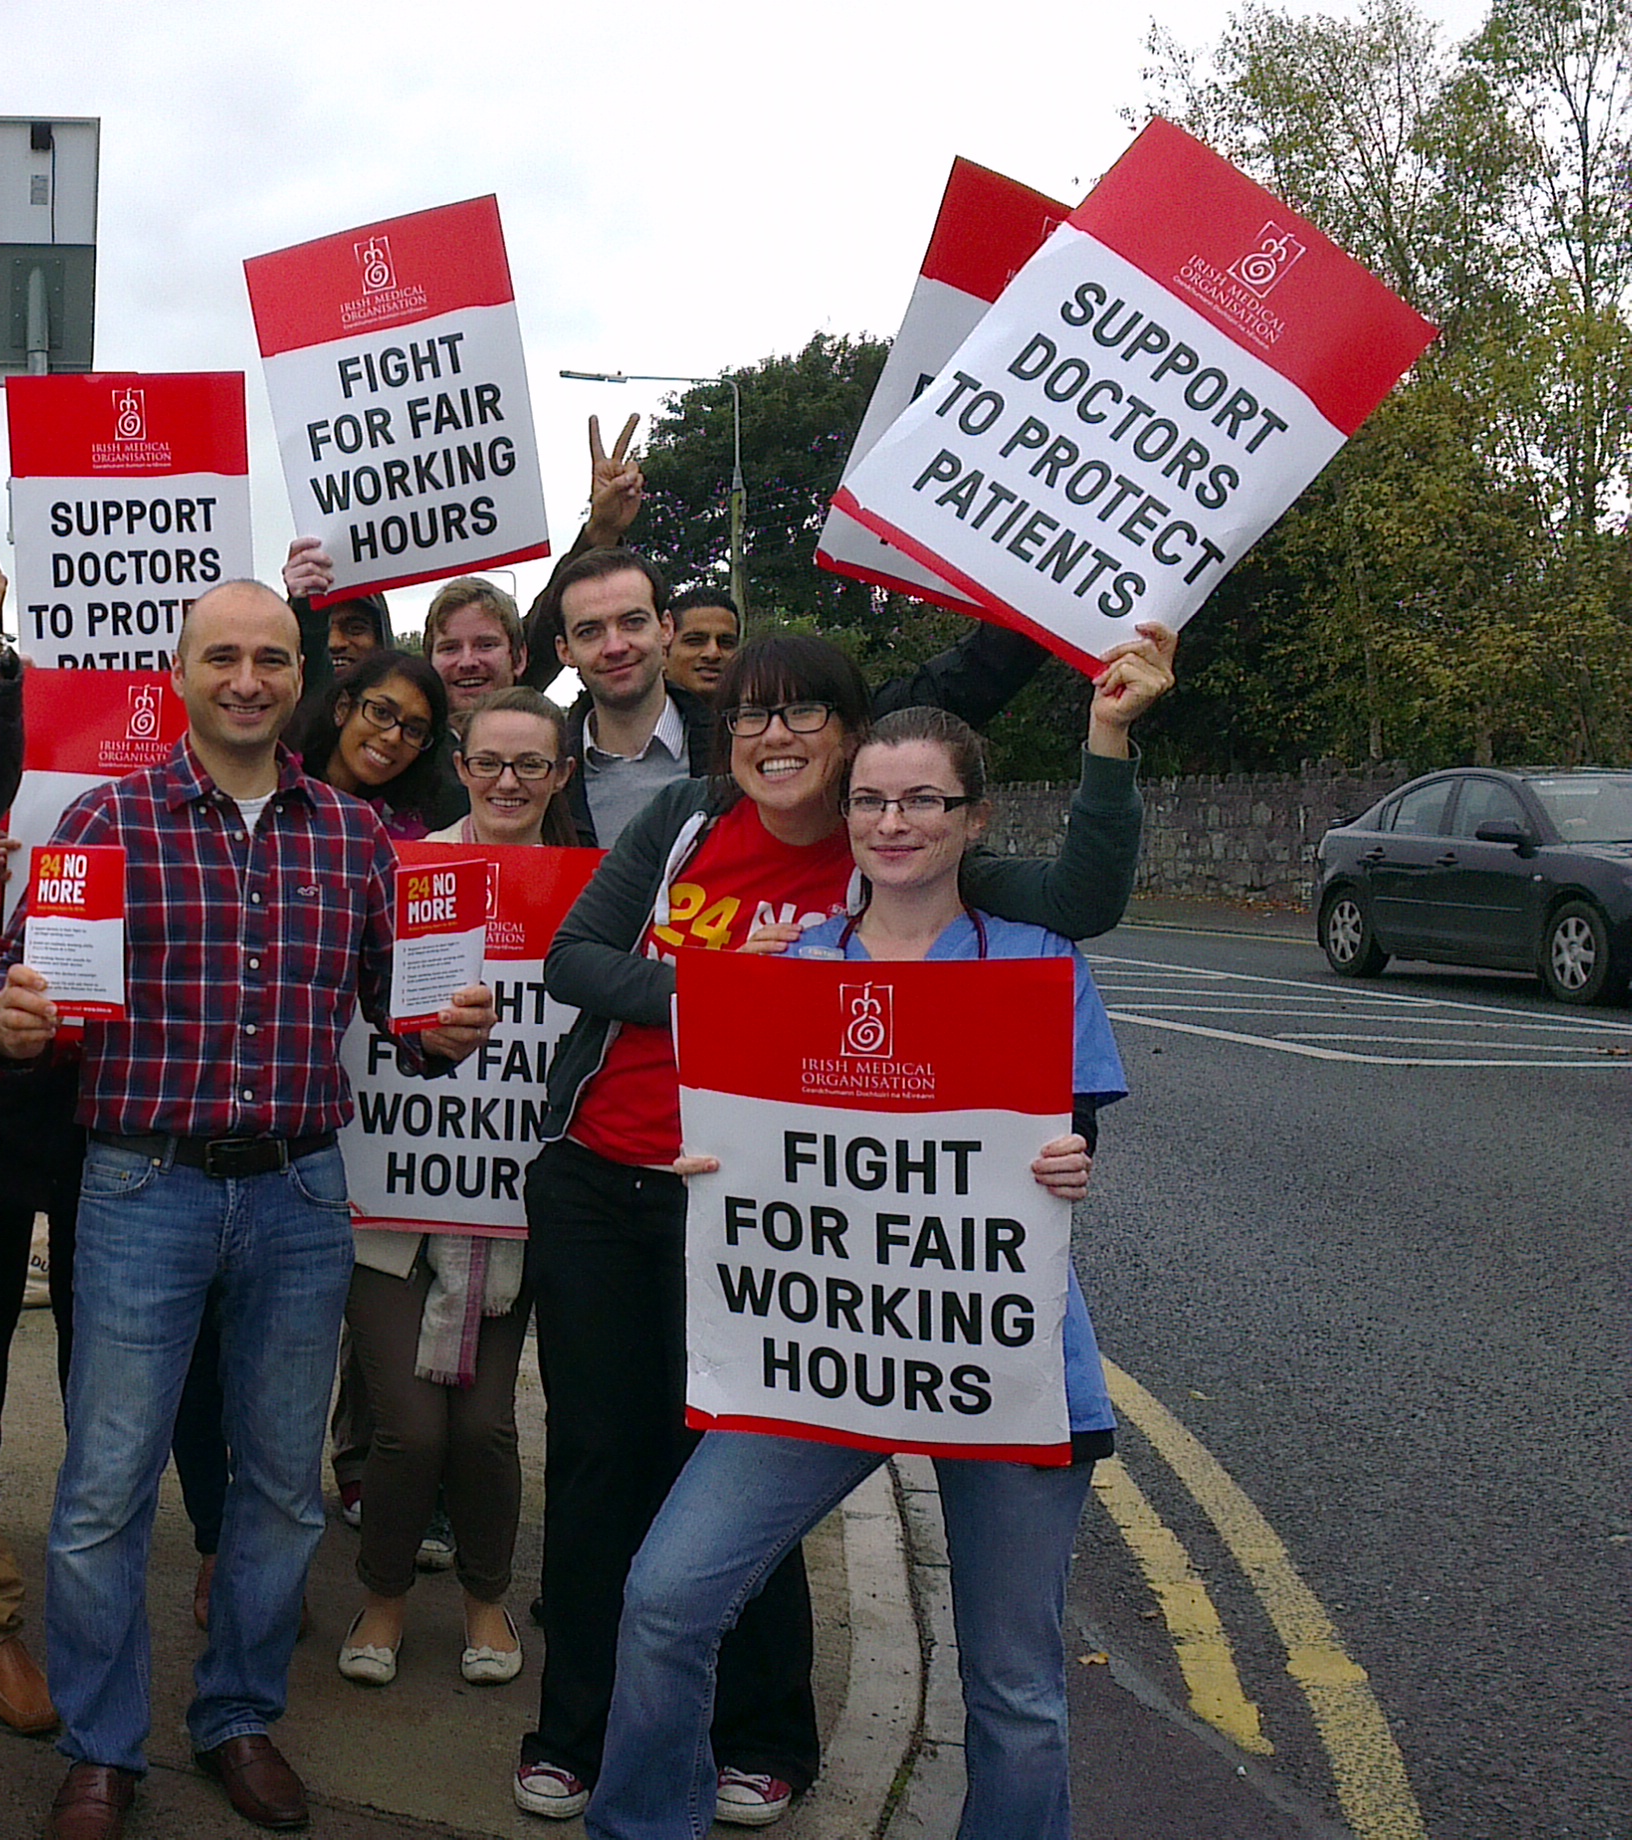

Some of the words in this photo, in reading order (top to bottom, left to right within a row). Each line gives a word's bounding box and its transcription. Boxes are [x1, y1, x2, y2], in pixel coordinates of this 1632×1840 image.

[340, 296, 371, 313] IRISH
[374, 284, 425, 304] MEDICAL
[341, 293, 427, 323] ORGANISATION
[1180, 265, 1280, 345] ORGANISATION
[1188, 254, 1228, 287] IRISH
[1227, 284, 1286, 334] MEDICAL
[338, 332, 464, 399] FIGHT
[1060, 281, 1289, 455] SUPPORT
[306, 407, 395, 462] FOR
[407, 382, 505, 439] FAIR
[1007, 332, 1240, 511] DOCTORS
[91, 443, 120, 453] IRISH
[124, 441, 171, 452] MEDICAL
[91, 451, 172, 463] ORGANISATION
[309, 435, 516, 516] WORKING
[935, 370, 1006, 436] TO
[998, 415, 1226, 586] PROTECT
[50, 497, 217, 537] SUPPORT
[349, 495, 498, 563] HOURS
[912, 448, 1147, 619] PATIENTS
[52, 548, 221, 588] DOCTORS
[28, 603, 74, 640] TO
[87, 599, 196, 638] PROT
[100, 740, 131, 752] IRISH
[134, 742, 174, 754] MEDIC
[39, 853, 61, 878] 24
[63, 853, 88, 879] NO
[407, 876, 430, 900] 24
[432, 872, 456, 898] NO
[37, 878, 87, 905] MORE
[407, 897, 457, 925] MORE
[487, 921, 526, 933] DICAL
[477, 1035, 564, 1084] FAI
[801, 1072, 936, 1091] ORGANISATION
[802, 1057, 848, 1073] IRISH
[855, 1062, 936, 1076] MEDICAL
[357, 1091, 550, 1143] WORKIN
[386, 1151, 521, 1200] HOUR
[783, 1130, 983, 1196] FIGHT
[724, 1195, 850, 1260] FOR
[876, 1212, 1026, 1273] FAIR
[716, 1262, 1035, 1348] WORKING
[762, 1336, 993, 1415] HOURS
